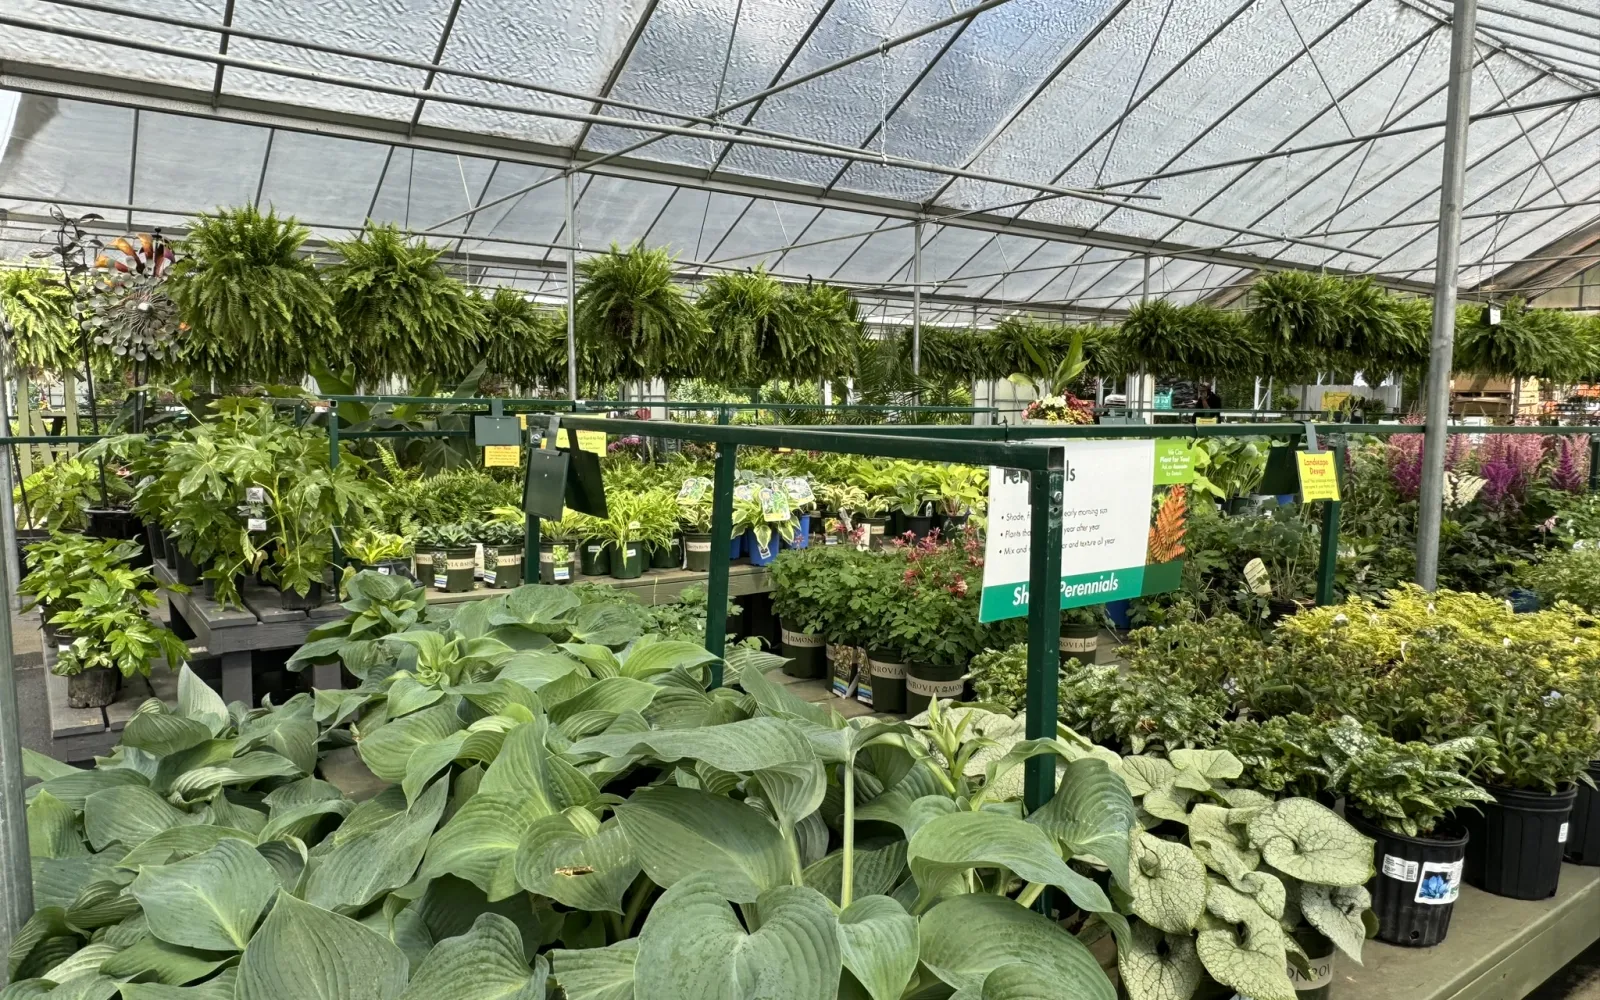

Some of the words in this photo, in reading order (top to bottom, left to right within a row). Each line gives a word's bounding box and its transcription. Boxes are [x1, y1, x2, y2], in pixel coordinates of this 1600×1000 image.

[1303, 457, 1329, 467] Landscape
[1309, 467, 1326, 477] Design
[1006, 512, 1026, 522] Shade,
[1063, 509, 1077, 519] early
[1078, 508, 1099, 518] morning
[1005, 530, 1022, 538] Plants
[1063, 525, 1076, 535] year
[1076, 523, 1088, 532] after
[1088, 522, 1101, 532] year
[1003, 547, 1015, 555] Mix
[1015, 544, 1027, 554] and
[1068, 538, 1080, 549] and
[1079, 537, 1097, 548] texture
[1104, 535, 1116, 545] year
[1060, 572, 1119, 598] Perennials
